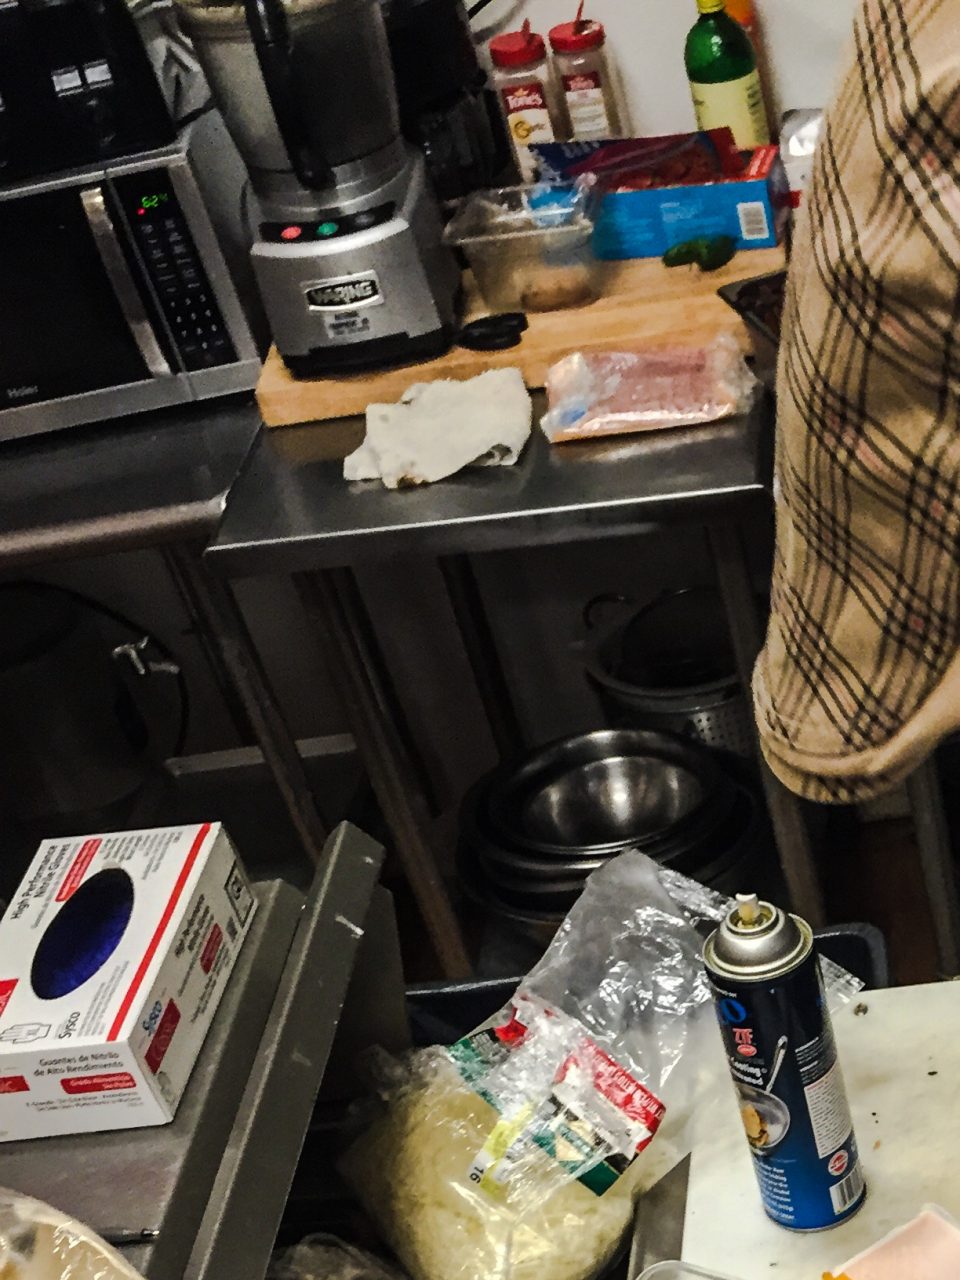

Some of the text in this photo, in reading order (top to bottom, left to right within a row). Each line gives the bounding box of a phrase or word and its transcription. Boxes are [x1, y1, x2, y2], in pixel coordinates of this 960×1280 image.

[10, 898, 30, 919] High
[22, 845, 57, 897] Performance
[33, 872, 55, 897] Nitrile
[48, 844, 71, 870] Gloves
[58, 1011, 80, 1039] Sysco
[469, 1166, 484, 1184] 16
